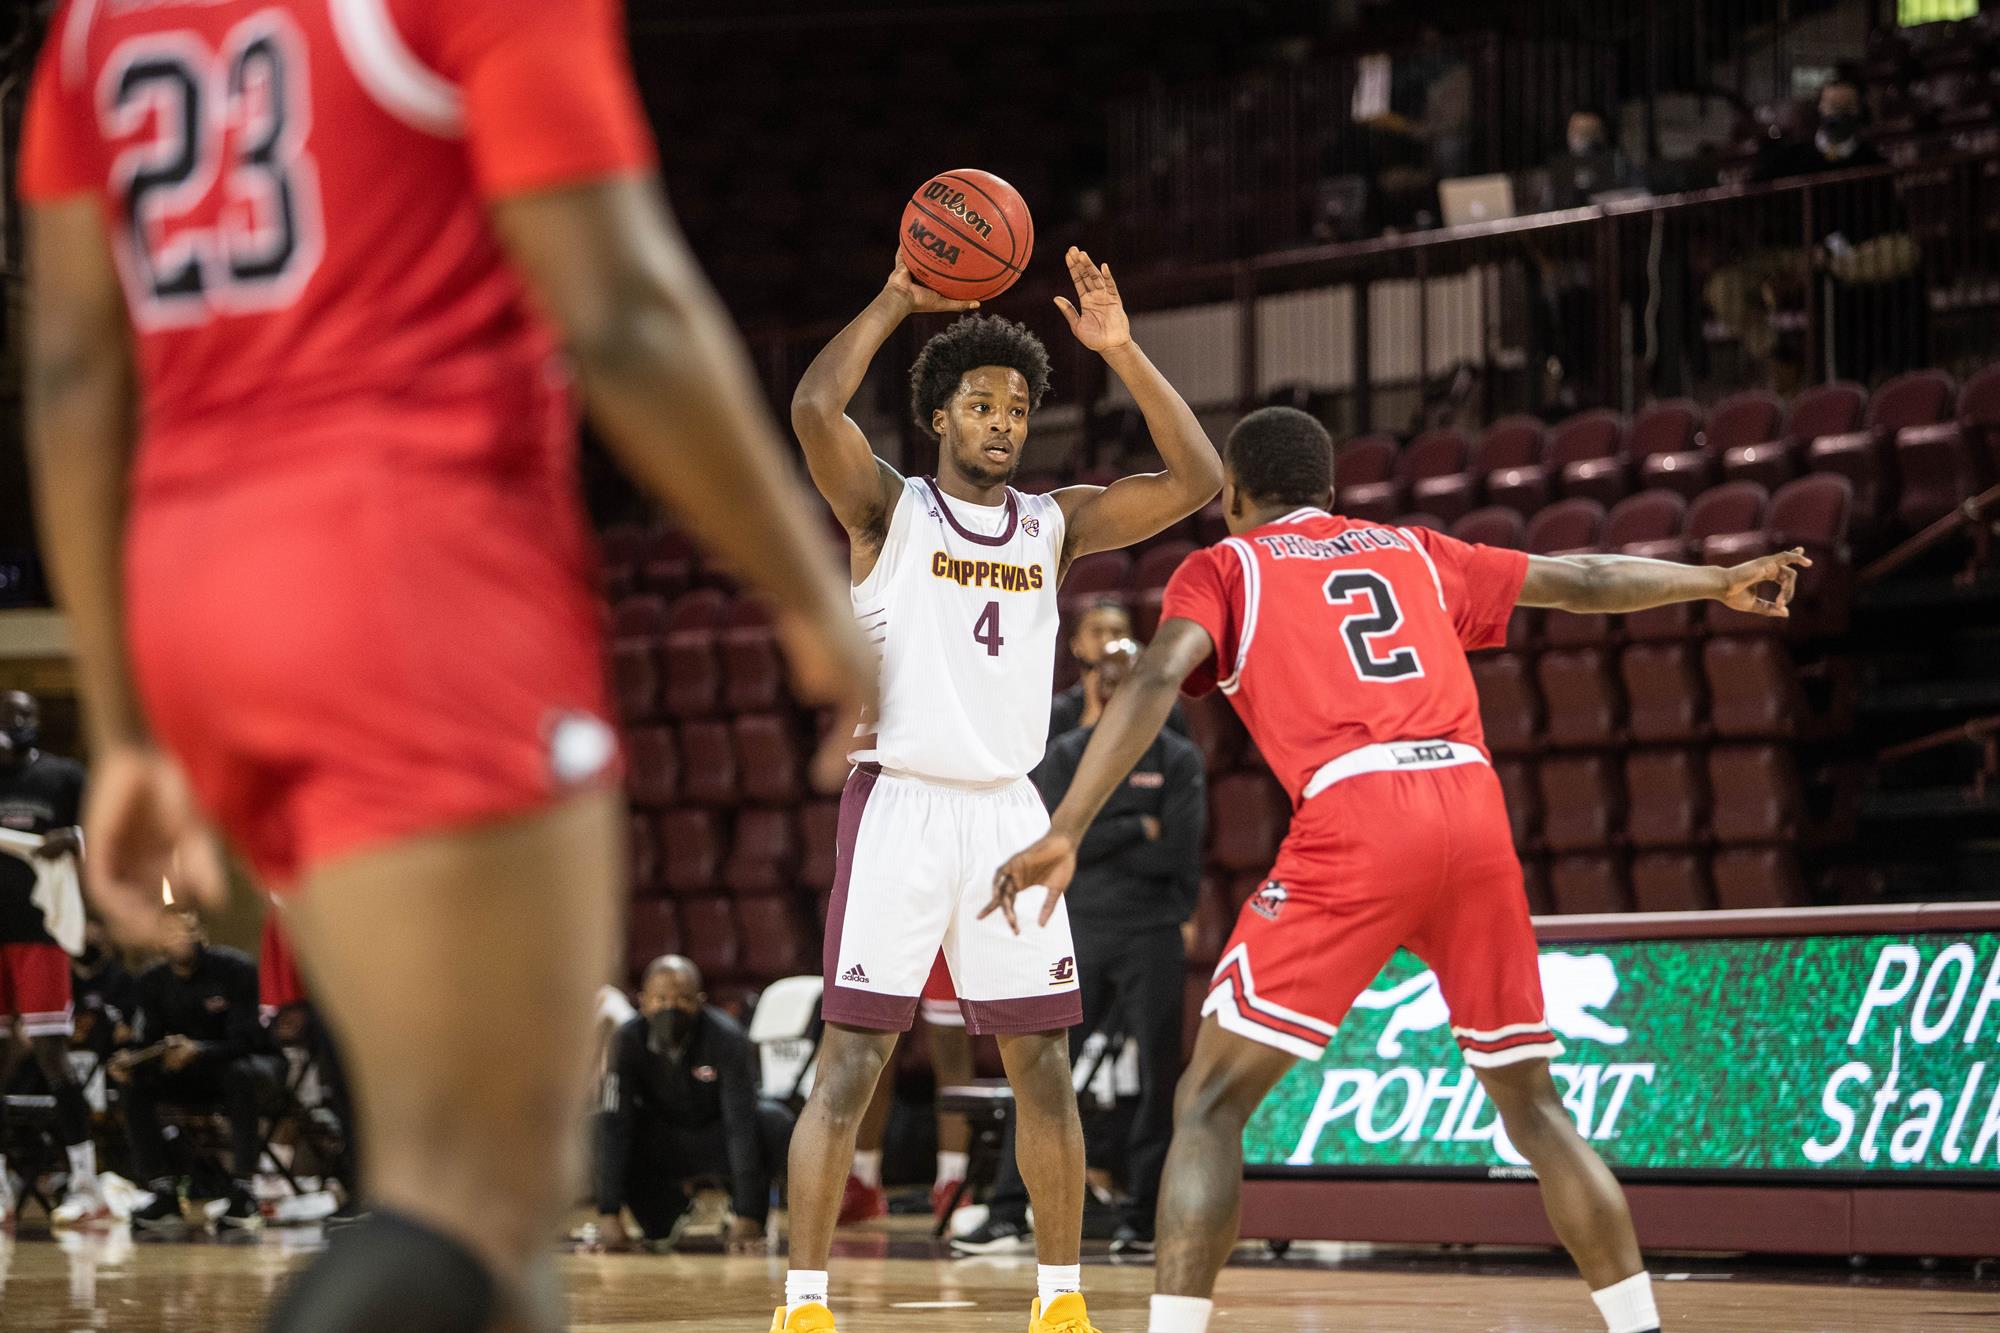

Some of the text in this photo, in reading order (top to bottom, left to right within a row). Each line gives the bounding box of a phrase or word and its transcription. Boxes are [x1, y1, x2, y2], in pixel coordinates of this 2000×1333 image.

[97, 8, 325, 331] 23
[907, 217, 962, 265] NCAA
[922, 181, 993, 241] Wilson
[973, 601, 1004, 657] 4
[1323, 568, 1425, 683] 2
[841, 974, 870, 983] adidas
[1286, 1063, 1656, 1165] POHLAT
